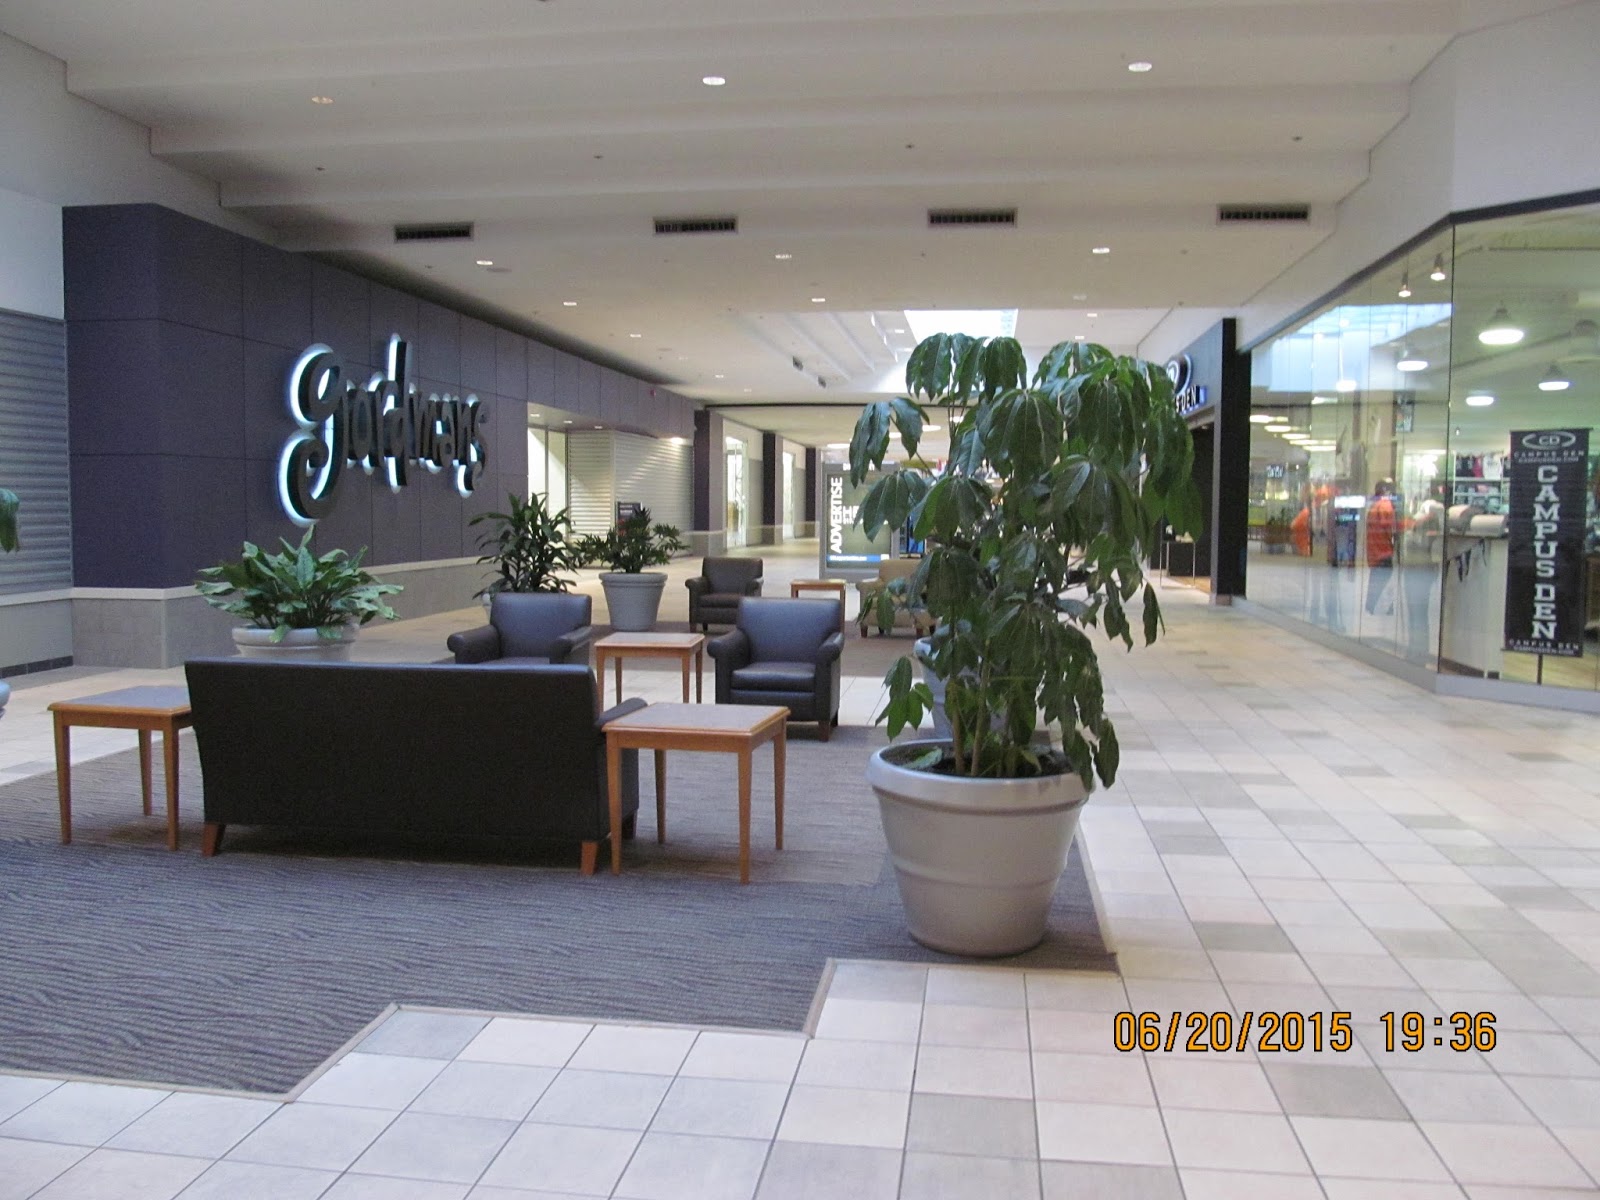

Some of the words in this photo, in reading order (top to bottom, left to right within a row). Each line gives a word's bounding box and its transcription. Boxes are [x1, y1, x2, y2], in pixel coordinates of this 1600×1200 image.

[830, 476, 843, 554] ADVERTISE
[1533, 465, 1559, 577] CAMPUS
[1531, 583, 1557, 640] DEN
